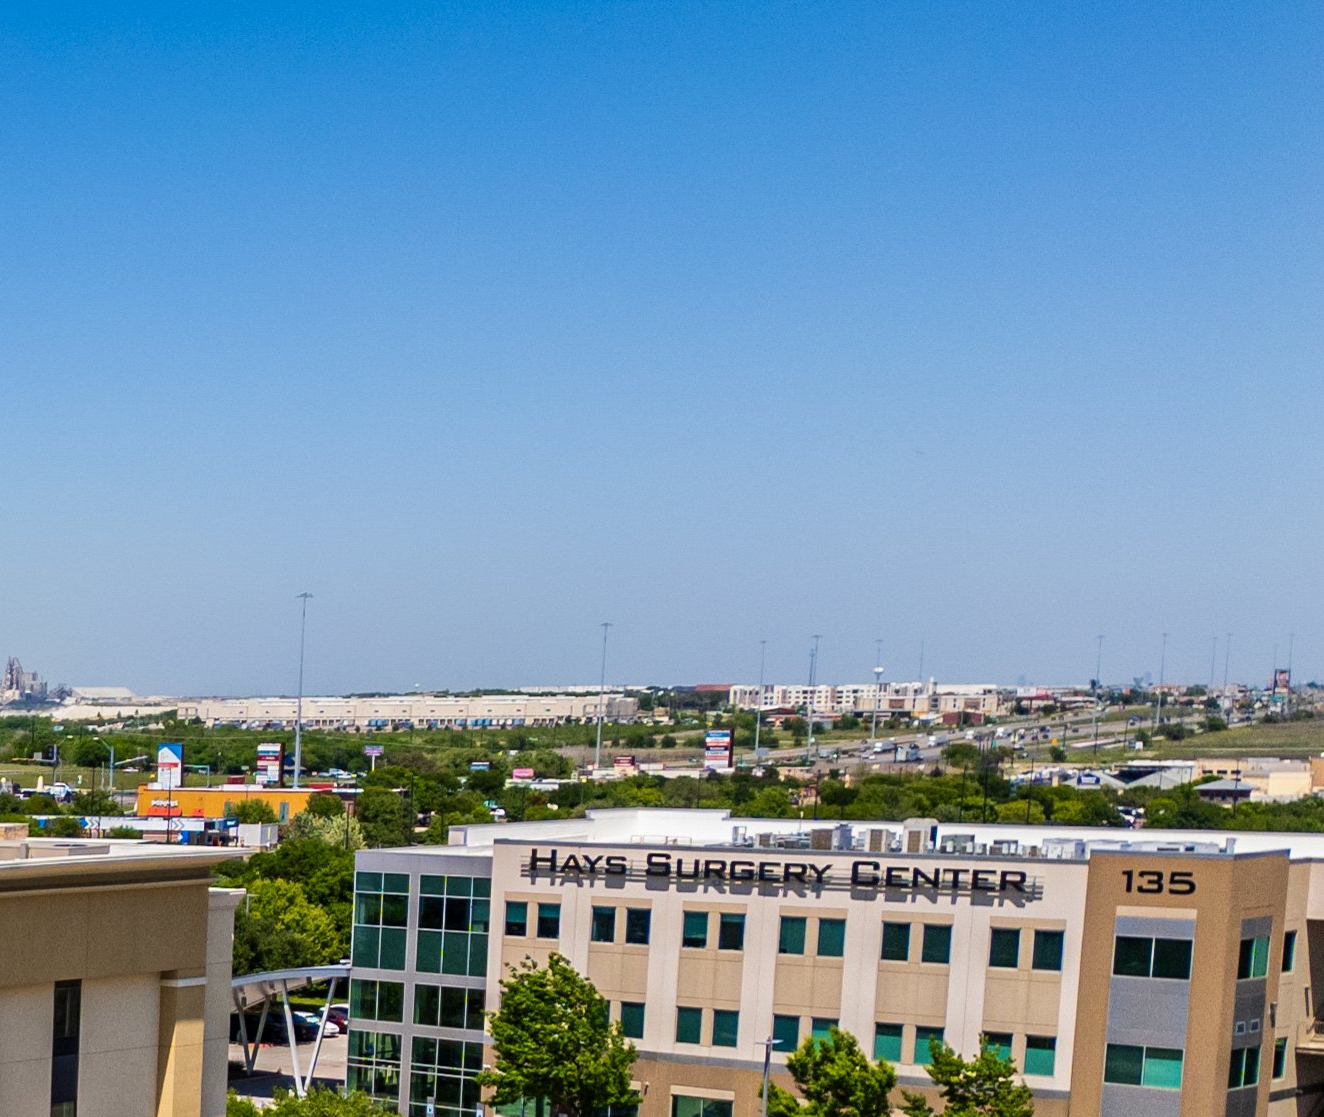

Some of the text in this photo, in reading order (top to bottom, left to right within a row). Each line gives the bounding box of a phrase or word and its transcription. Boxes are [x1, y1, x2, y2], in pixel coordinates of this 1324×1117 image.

[529, 848, 1027, 892] HAYS SURGERY CENTER
[1121, 869, 1196, 896] 135
